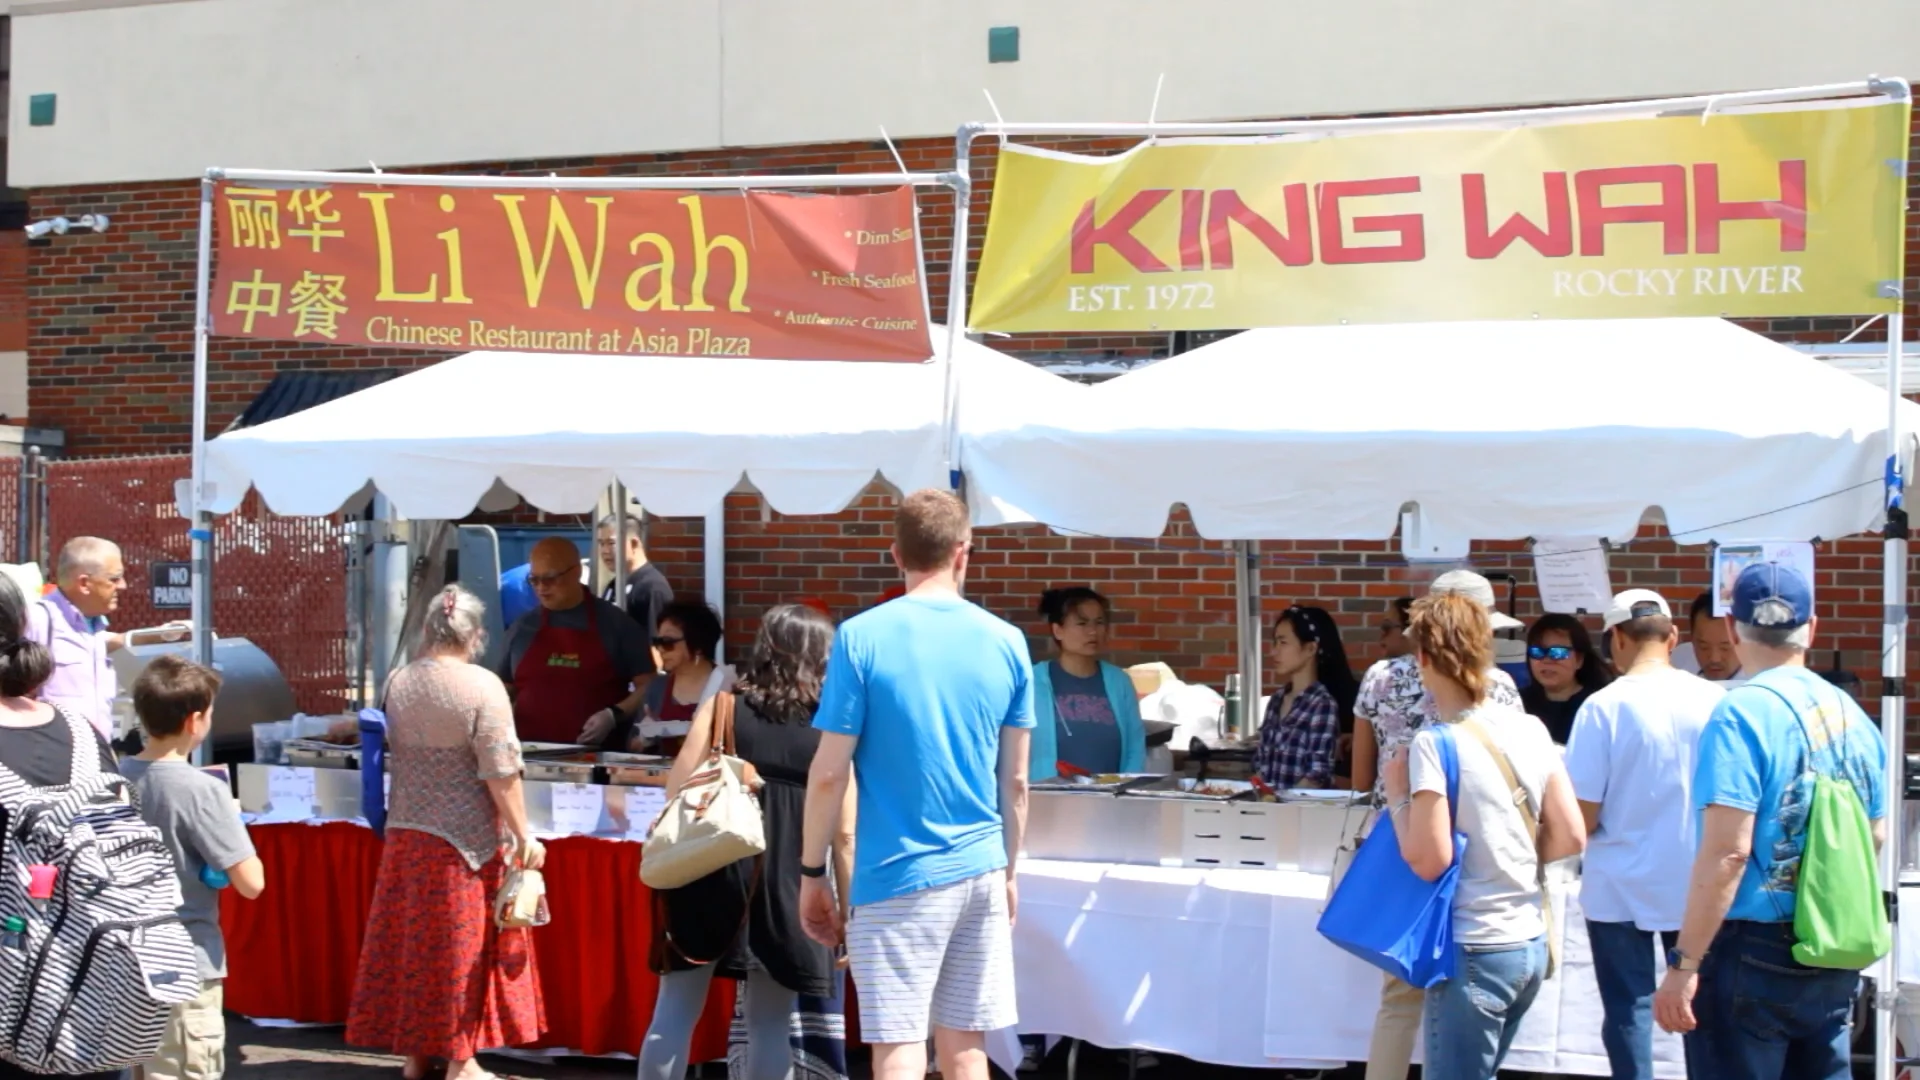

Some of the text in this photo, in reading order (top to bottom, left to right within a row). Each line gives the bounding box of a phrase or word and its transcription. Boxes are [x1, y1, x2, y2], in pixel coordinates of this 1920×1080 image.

[224, 186, 345, 252] 丽华
[1070, 160, 1807, 274] KING WAH
[358, 191, 751, 313] Li Wah
[856, 230, 890, 245] Dim
[821, 268, 917, 289] Fresh Seafood
[1553, 265, 1805, 298] ROCKY RIVER
[226, 269, 348, 340] 中餐
[1067, 282, 1216, 313] EST. 1972
[366, 316, 751, 356] Chinese Restaurant at Asia Plaza
[785, 310, 918, 331] Authentic Cuisine
[169, 567, 189, 585] NO
[154, 586, 193, 604] PARKIN
